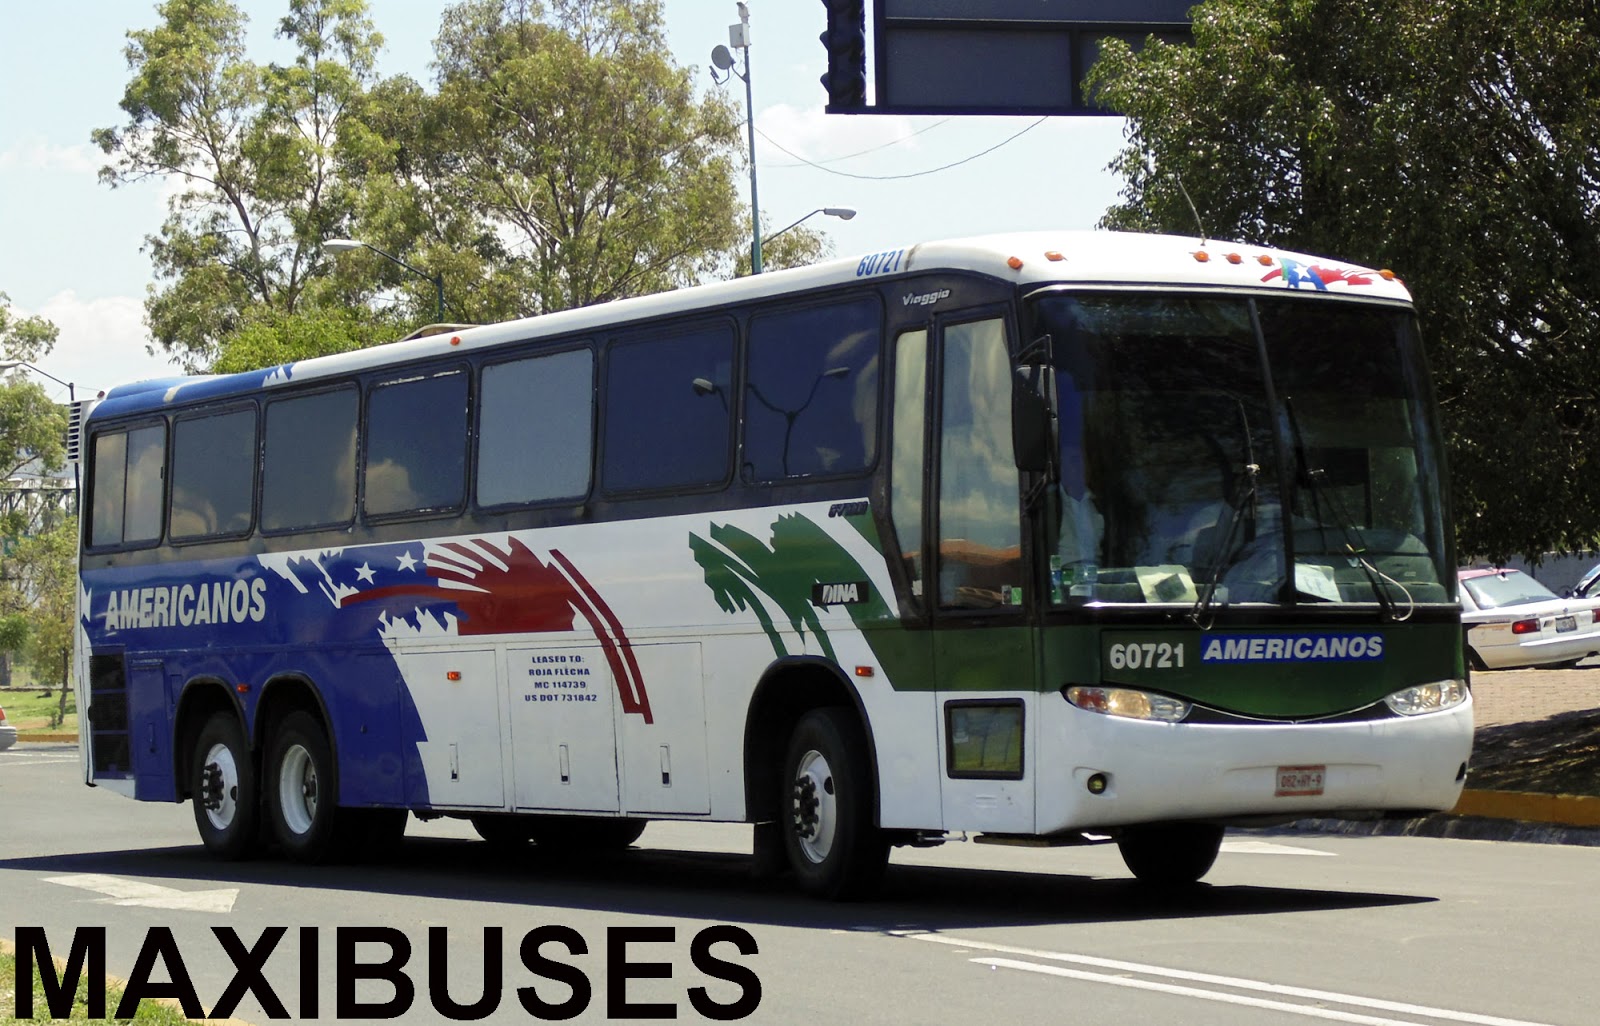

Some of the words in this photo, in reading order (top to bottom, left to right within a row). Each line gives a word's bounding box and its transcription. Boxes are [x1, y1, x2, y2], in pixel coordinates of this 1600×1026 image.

[856, 249, 904, 277] 60721
[902, 288, 951, 306] Viaggio
[822, 583, 859, 603] DINA
[105, 577, 267, 631] AMERICANOS
[1109, 643, 1185, 669] 60721
[1203, 636, 1384, 660] AMERICANOS
[532, 655, 566, 663] LEASED
[528, 668, 553, 676] ROJA
[555, 668, 590, 676] FLECHA
[534, 681, 550, 689] MC
[524, 694, 538, 702] US
[539, 694, 559, 702] DOT
[562, 694, 597, 702] 731842
